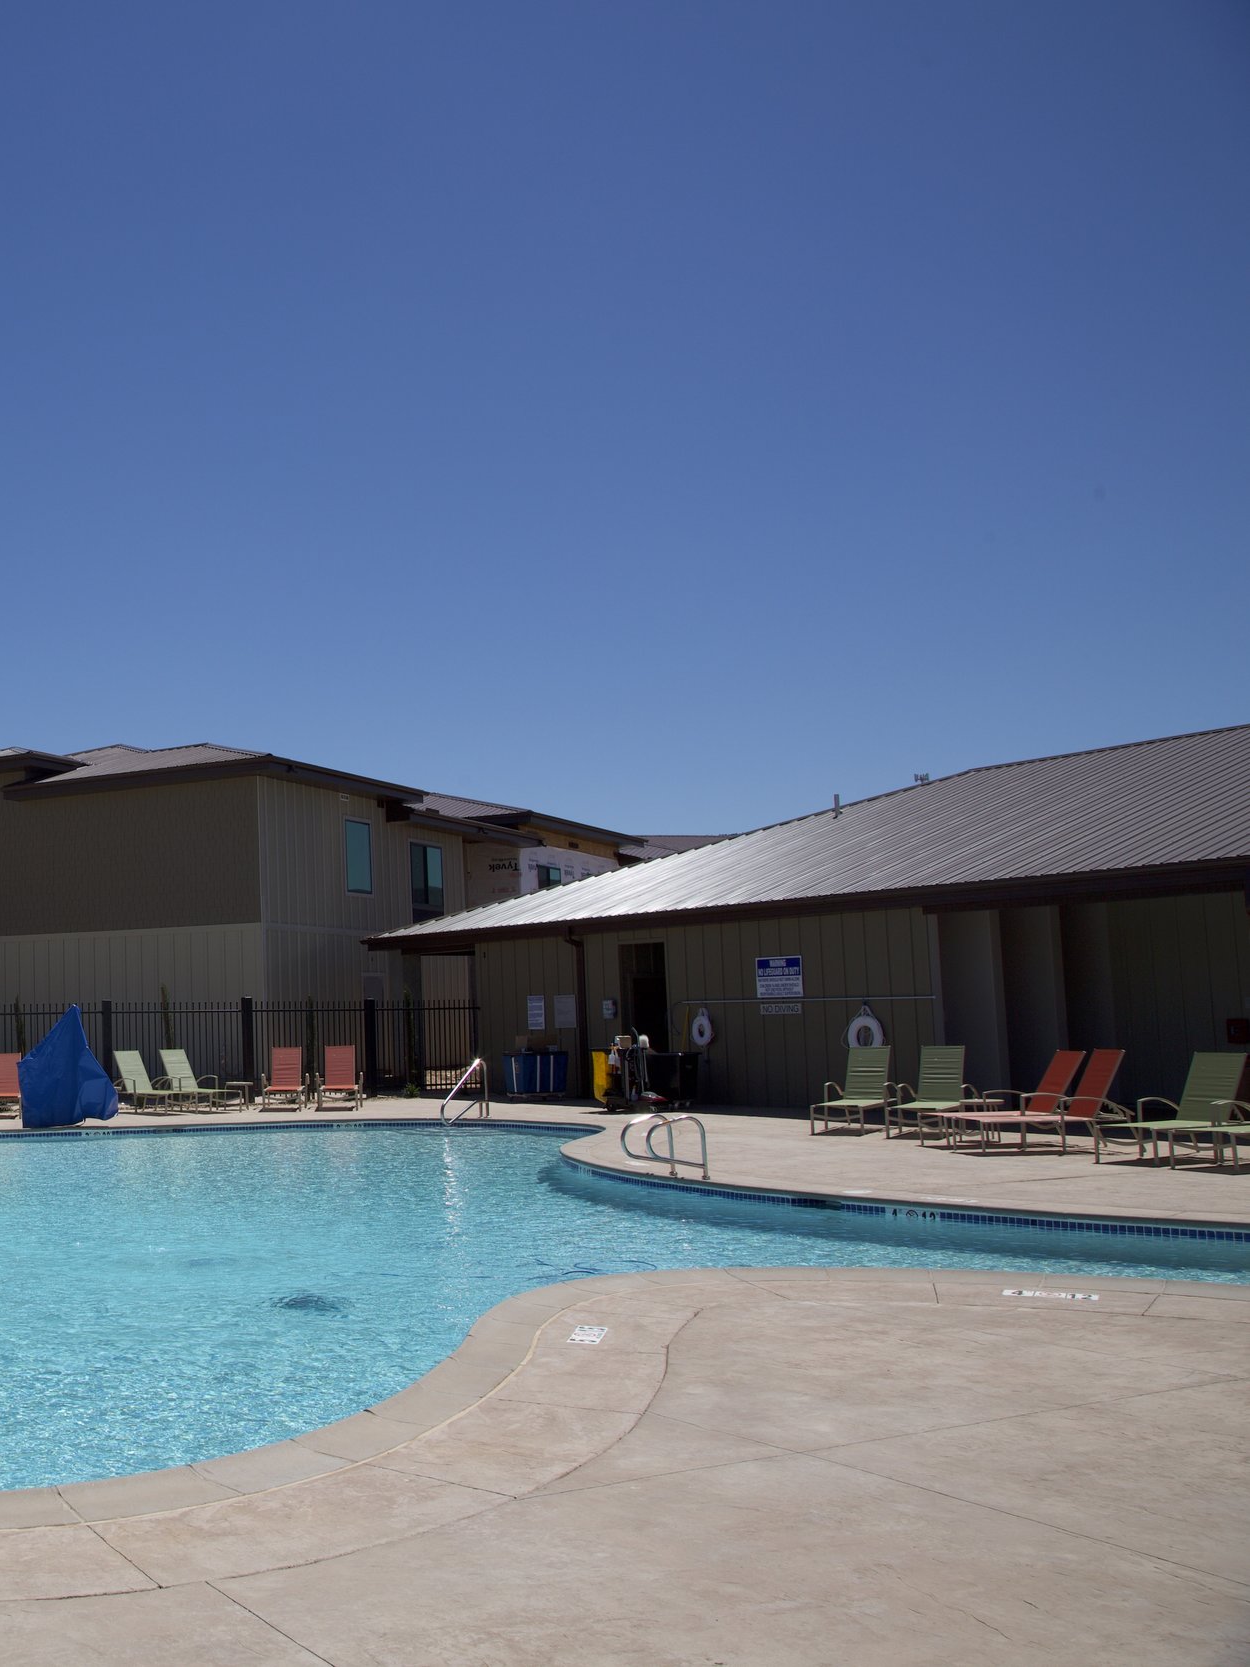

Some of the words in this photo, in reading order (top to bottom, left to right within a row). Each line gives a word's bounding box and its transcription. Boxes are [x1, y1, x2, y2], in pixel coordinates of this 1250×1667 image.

[489, 861, 521, 872] Tyvek
[762, 1005, 773, 1013] NO
[774, 1004, 799, 1013] DIVING
